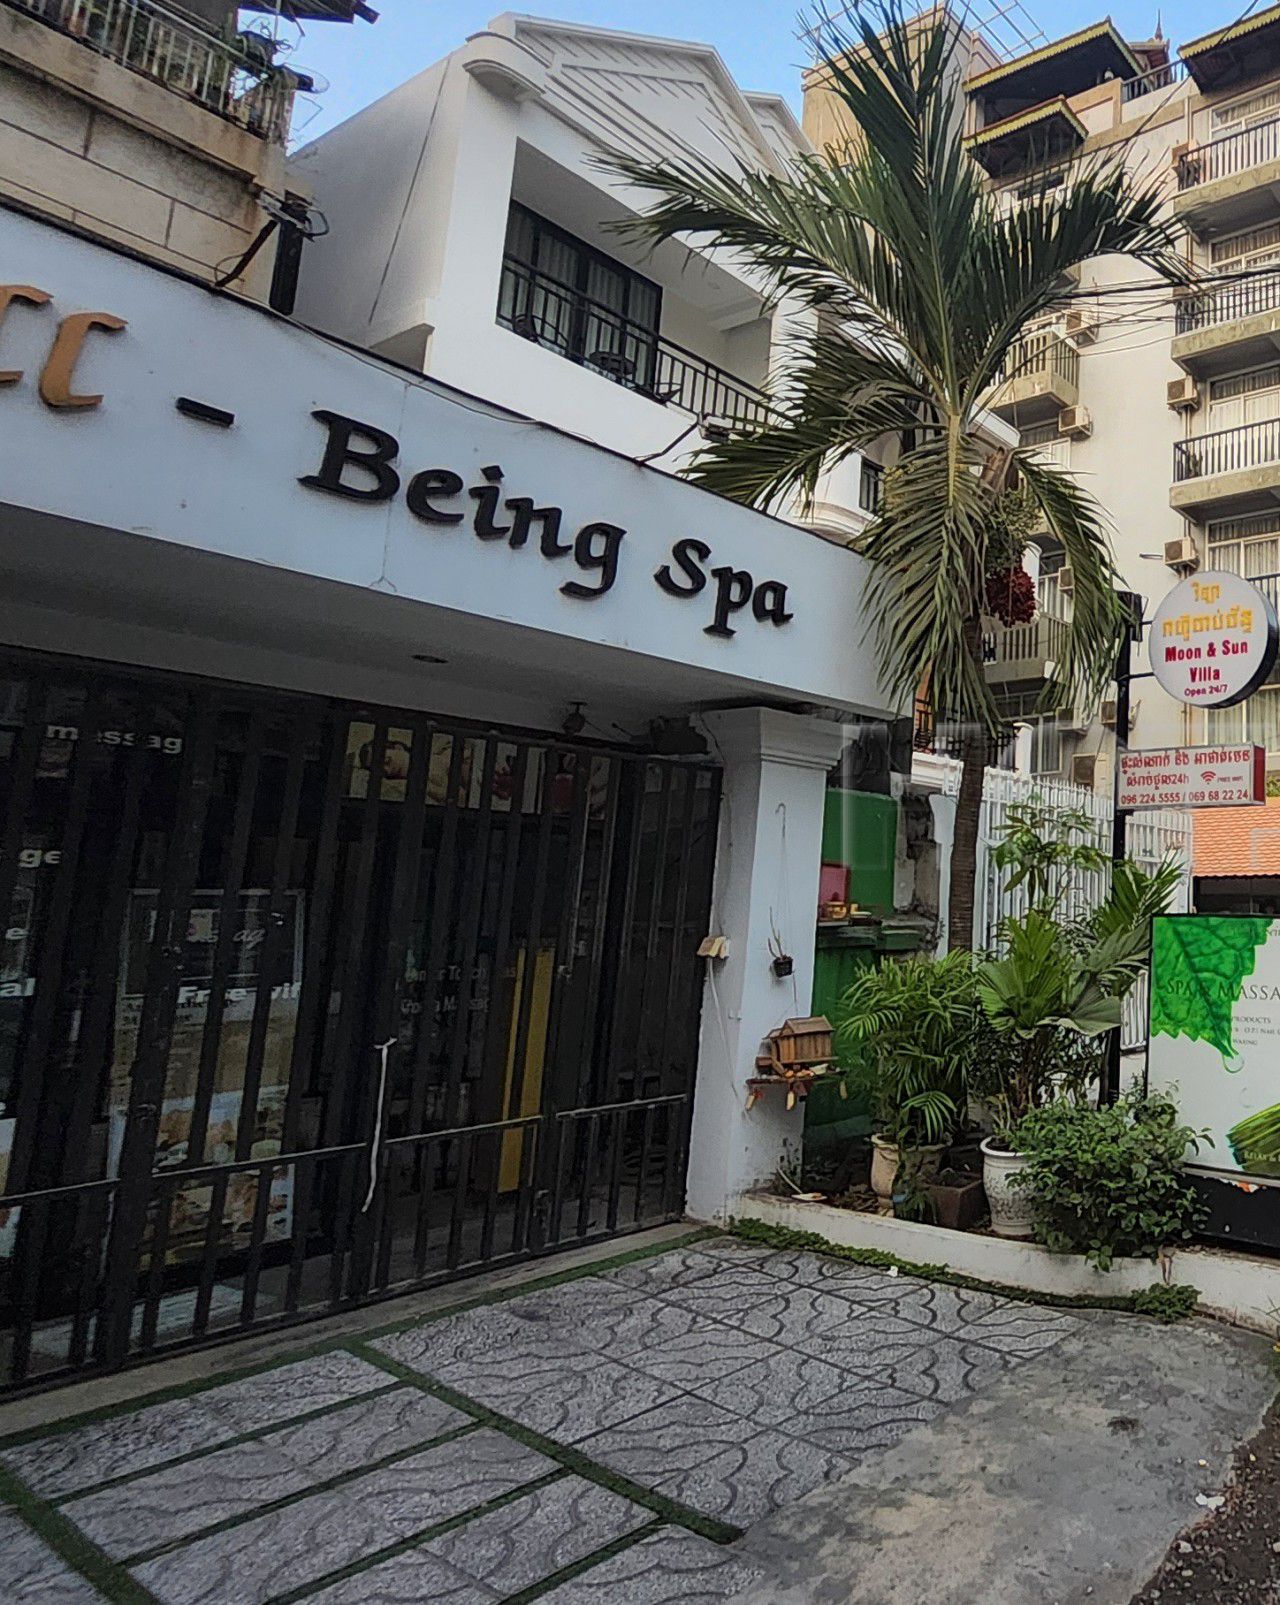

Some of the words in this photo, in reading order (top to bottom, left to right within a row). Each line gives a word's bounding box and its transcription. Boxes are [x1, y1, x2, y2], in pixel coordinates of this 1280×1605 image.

[297, 409, 627, 600] Being
[654, 537, 795, 638] Spa
[1165, 645, 1201, 662] Moon
[1207, 642, 1216, 658] &
[1222, 639, 1248, 656] Sun
[1190, 666, 1220, 683] Villa
[1184, 687, 1206, 697] Open
[1209, 684, 1228, 695] 24/7
[1121, 795, 1137, 804] 096
[1140, 793, 1155, 804] 224
[1158, 792, 1180, 803] 5555
[1189, 791, 1205, 801] 069
[1208, 790, 1220, 801] 68
[1222, 790, 1234, 800] 22
[1237, 789, 1248, 799] 24
